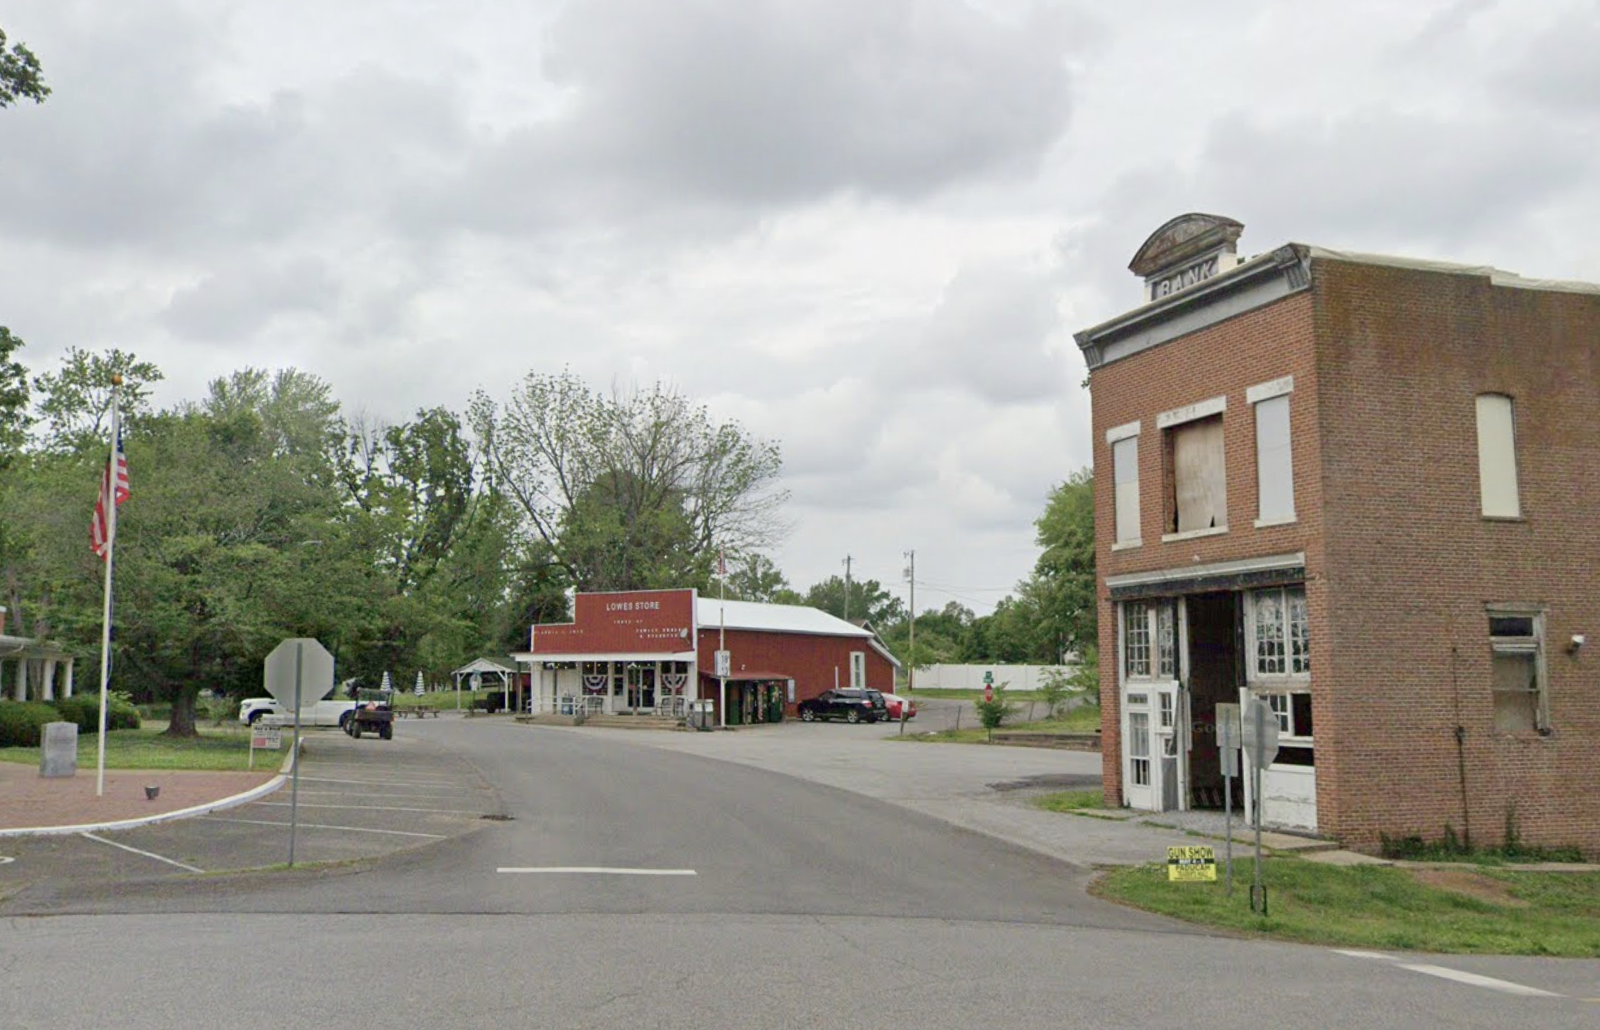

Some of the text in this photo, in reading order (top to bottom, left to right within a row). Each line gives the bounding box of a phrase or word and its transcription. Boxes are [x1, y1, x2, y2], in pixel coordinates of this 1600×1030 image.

[1160, 261, 1213, 297] BANK
[606, 601, 660, 611] LOWES STORE
[1168, 847, 1213, 858] GUN SHOW
